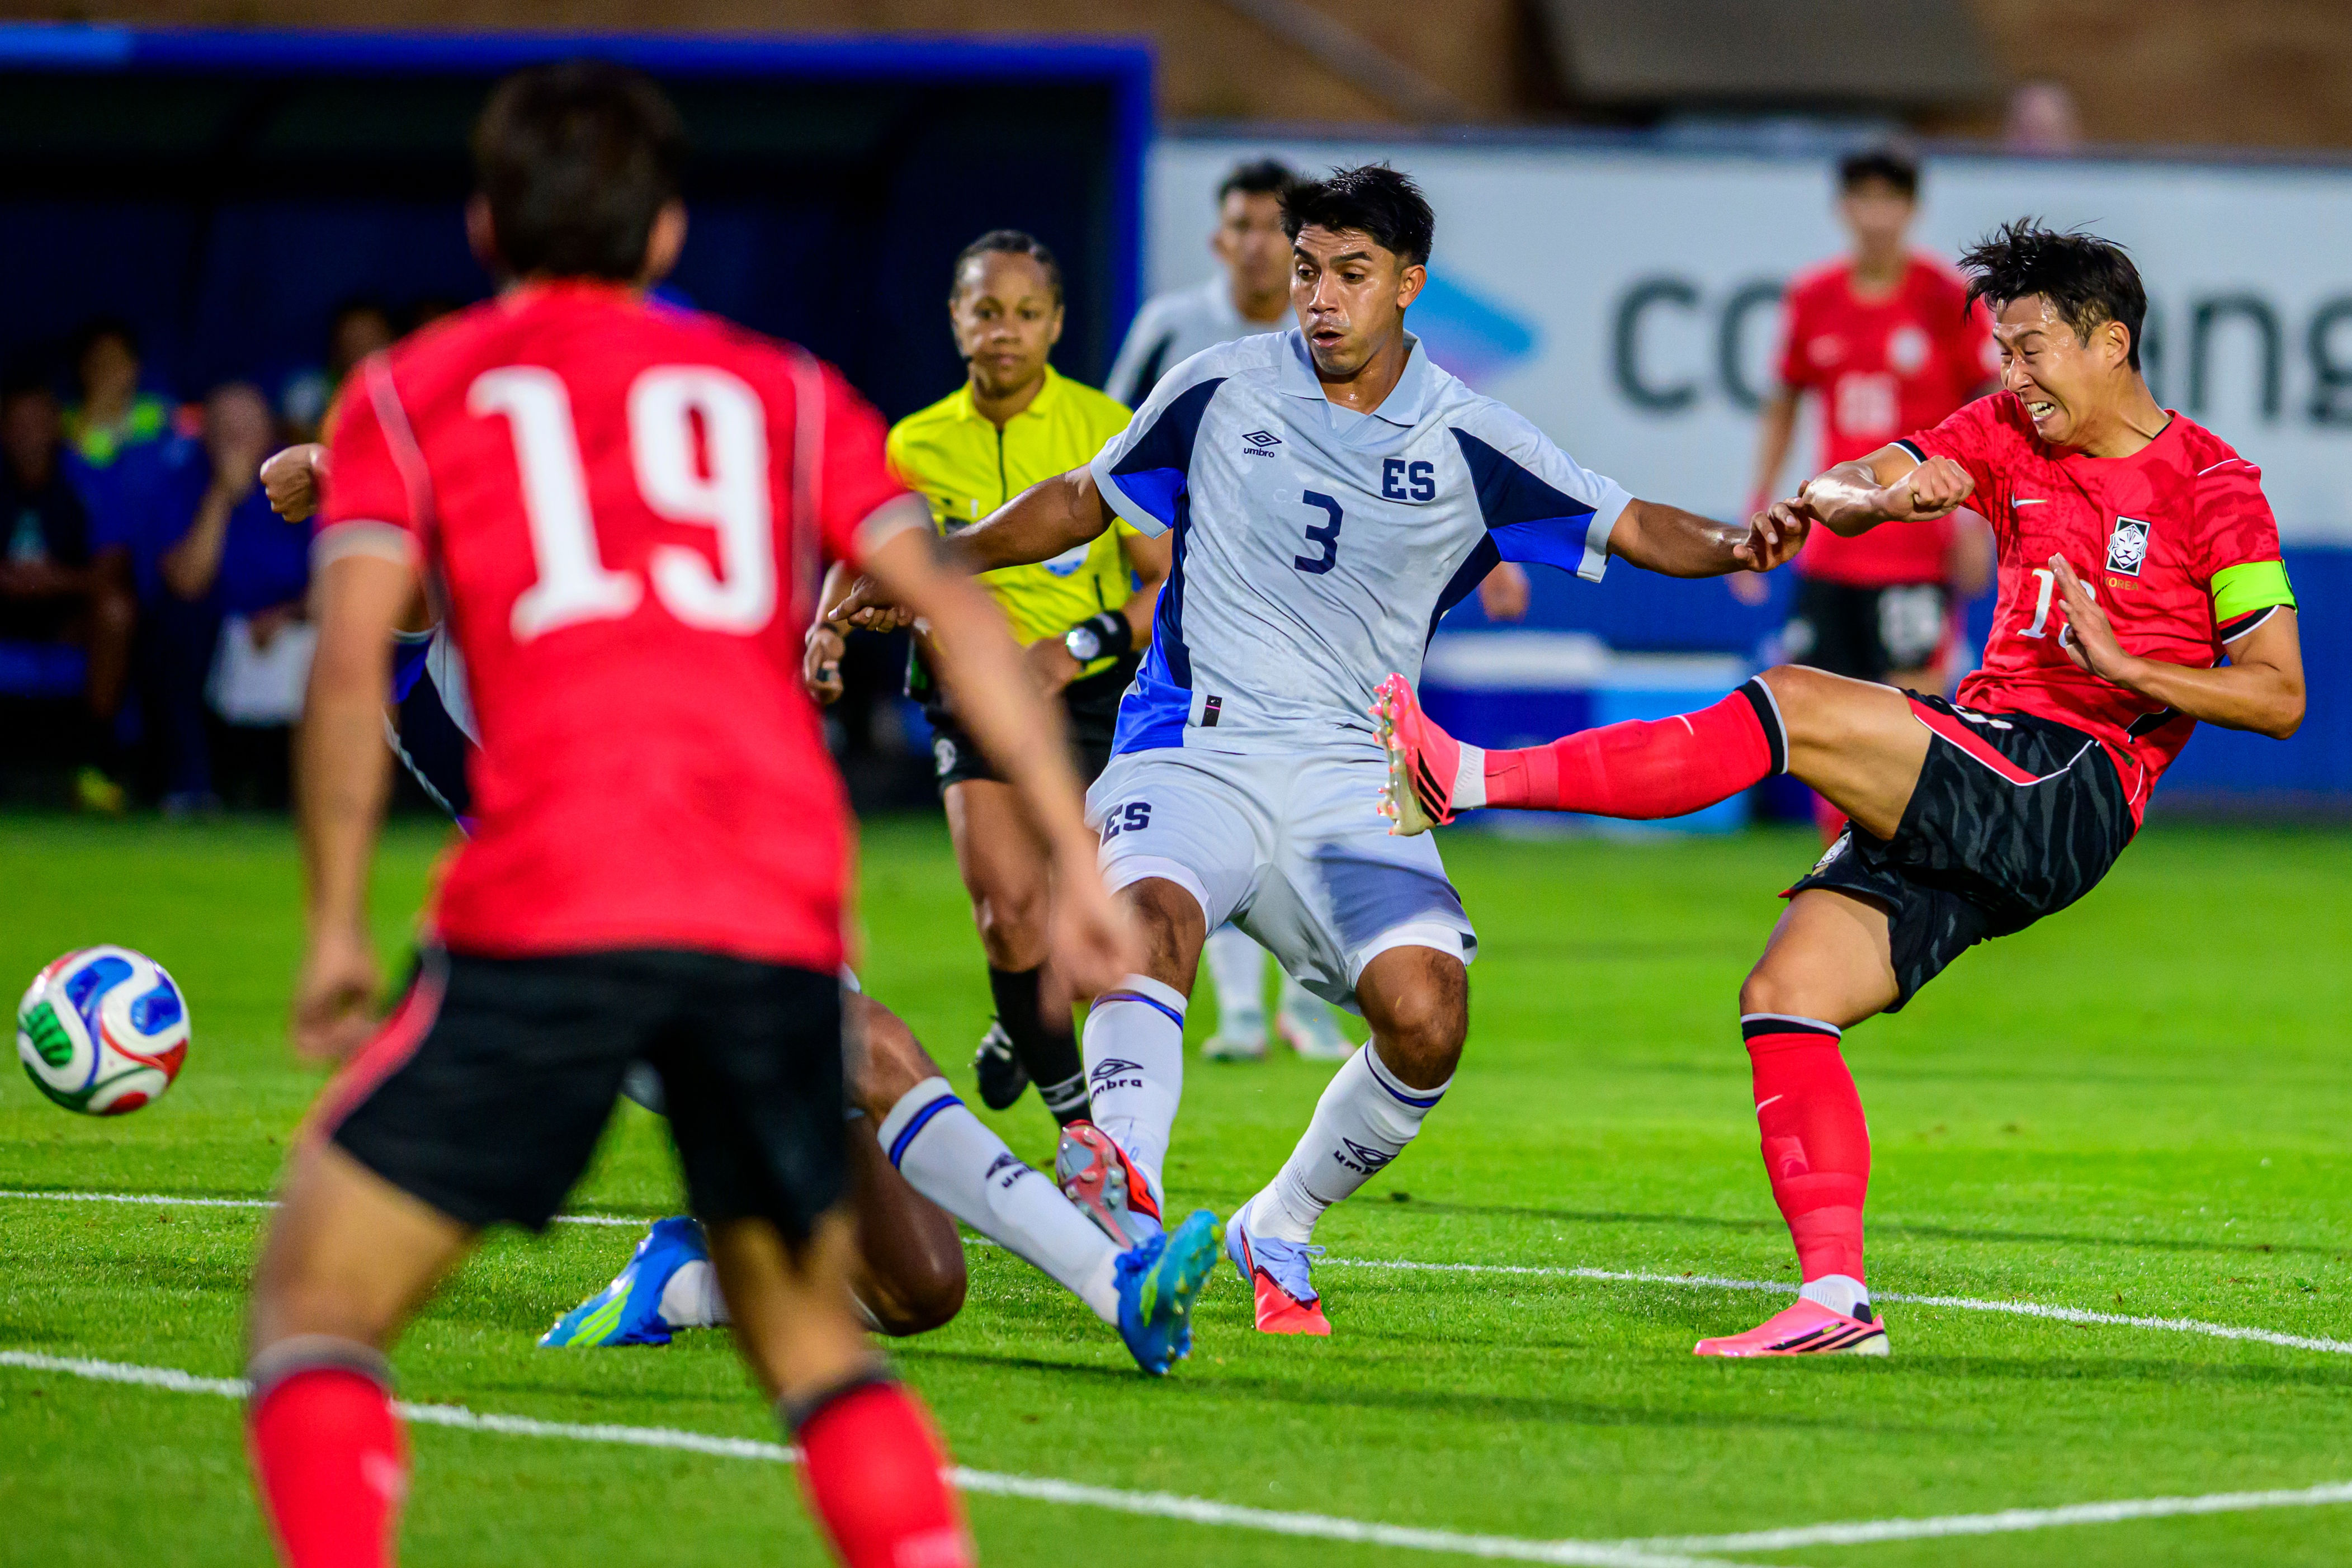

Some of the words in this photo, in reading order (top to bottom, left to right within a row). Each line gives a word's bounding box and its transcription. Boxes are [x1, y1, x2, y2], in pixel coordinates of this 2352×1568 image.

[1244, 448, 1274, 458] umbro
[1382, 458, 1435, 501] ES
[466, 364, 777, 644] 19
[1294, 489, 1344, 575] 3
[1102, 802, 1152, 847] ES
